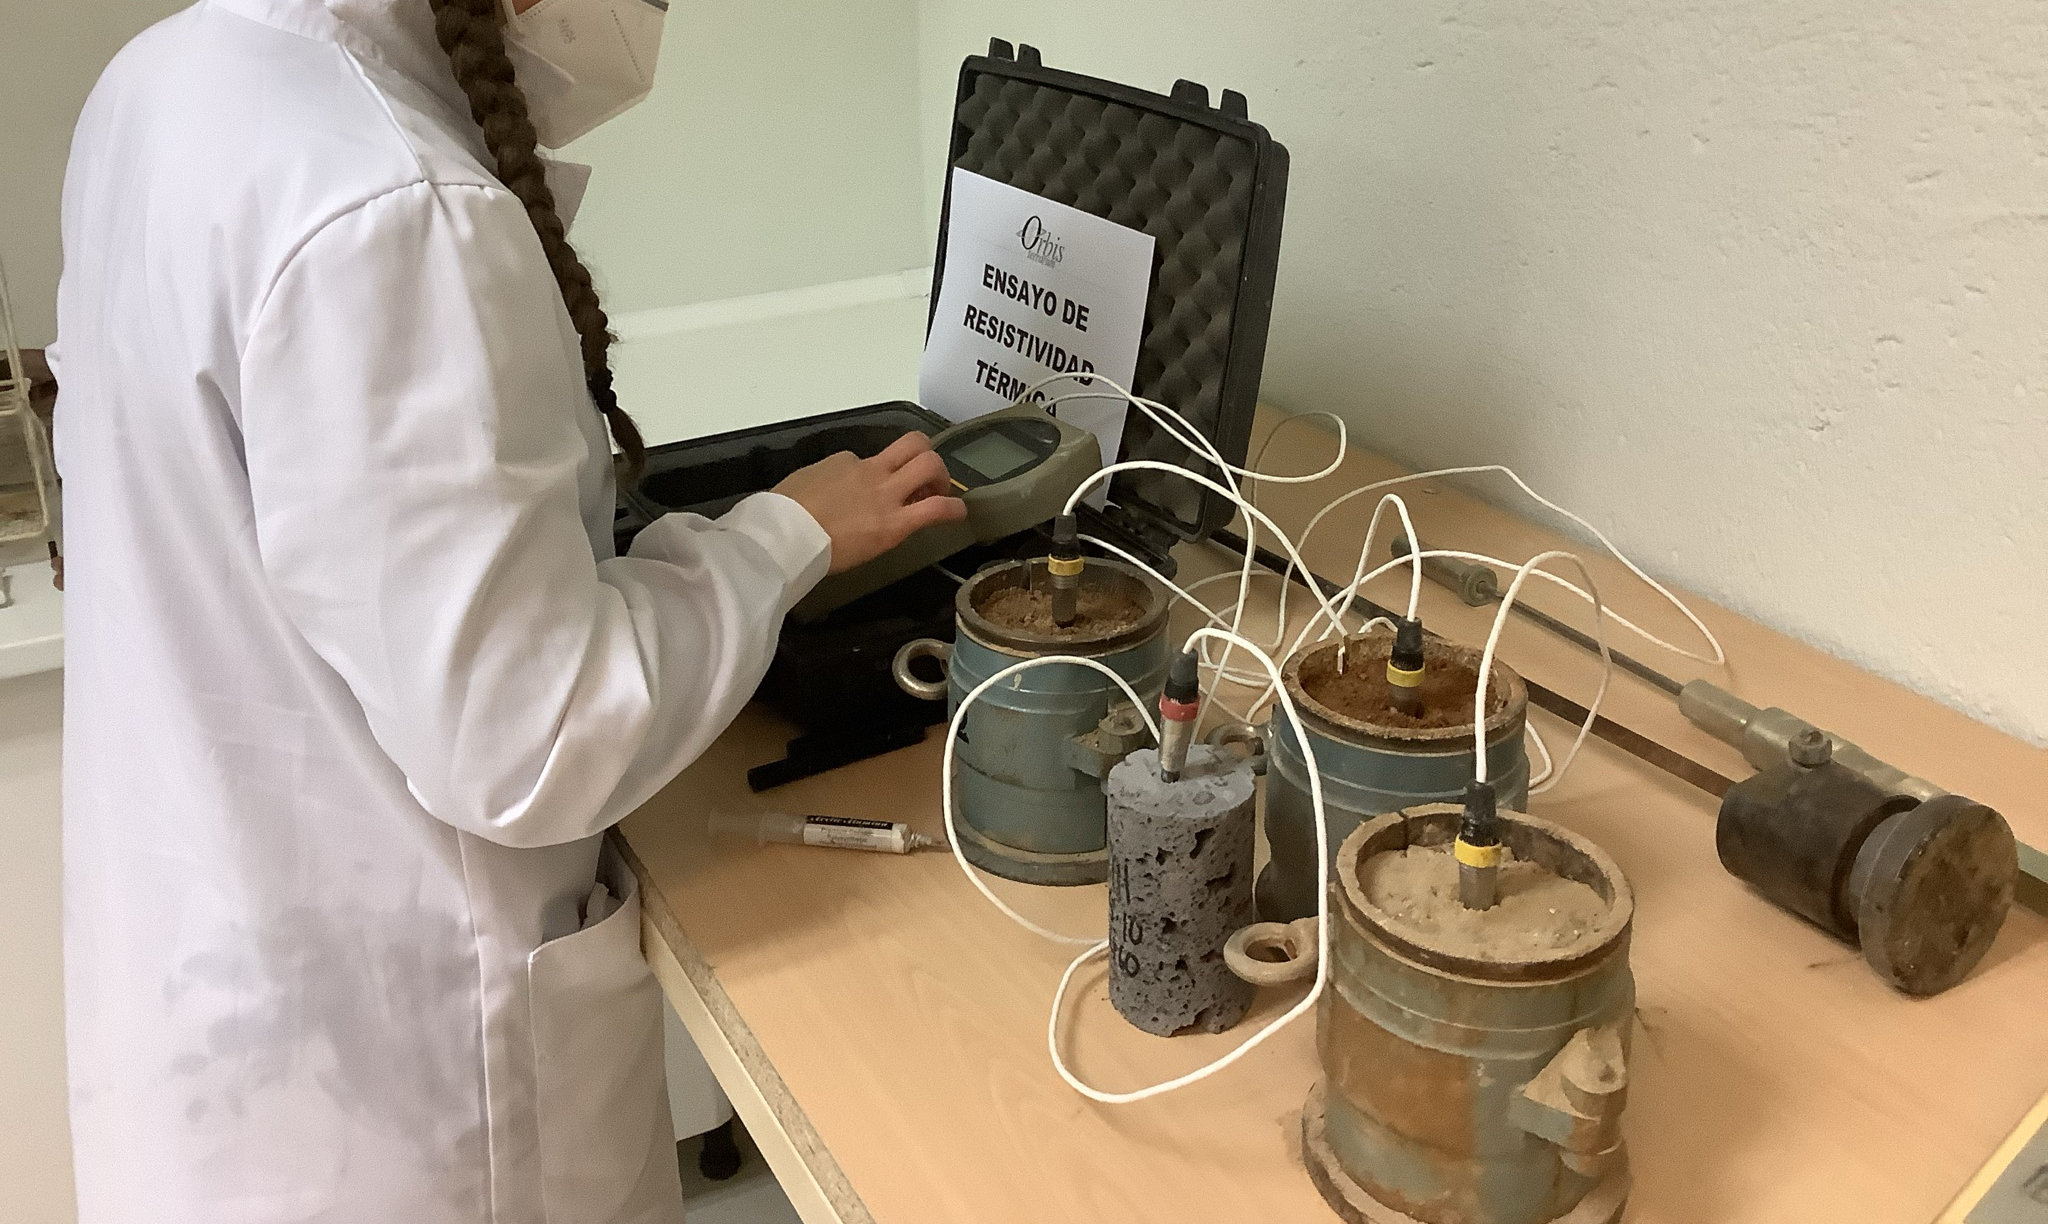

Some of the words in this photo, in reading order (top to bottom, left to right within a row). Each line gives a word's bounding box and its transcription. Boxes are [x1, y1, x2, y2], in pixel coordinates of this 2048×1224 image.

[1020, 215, 1065, 263] Orbis
[982, 263, 1057, 316] ENSAYO
[1062, 298, 1090, 332] DE
[963, 304, 1095, 386] RESISTIVIDAD
